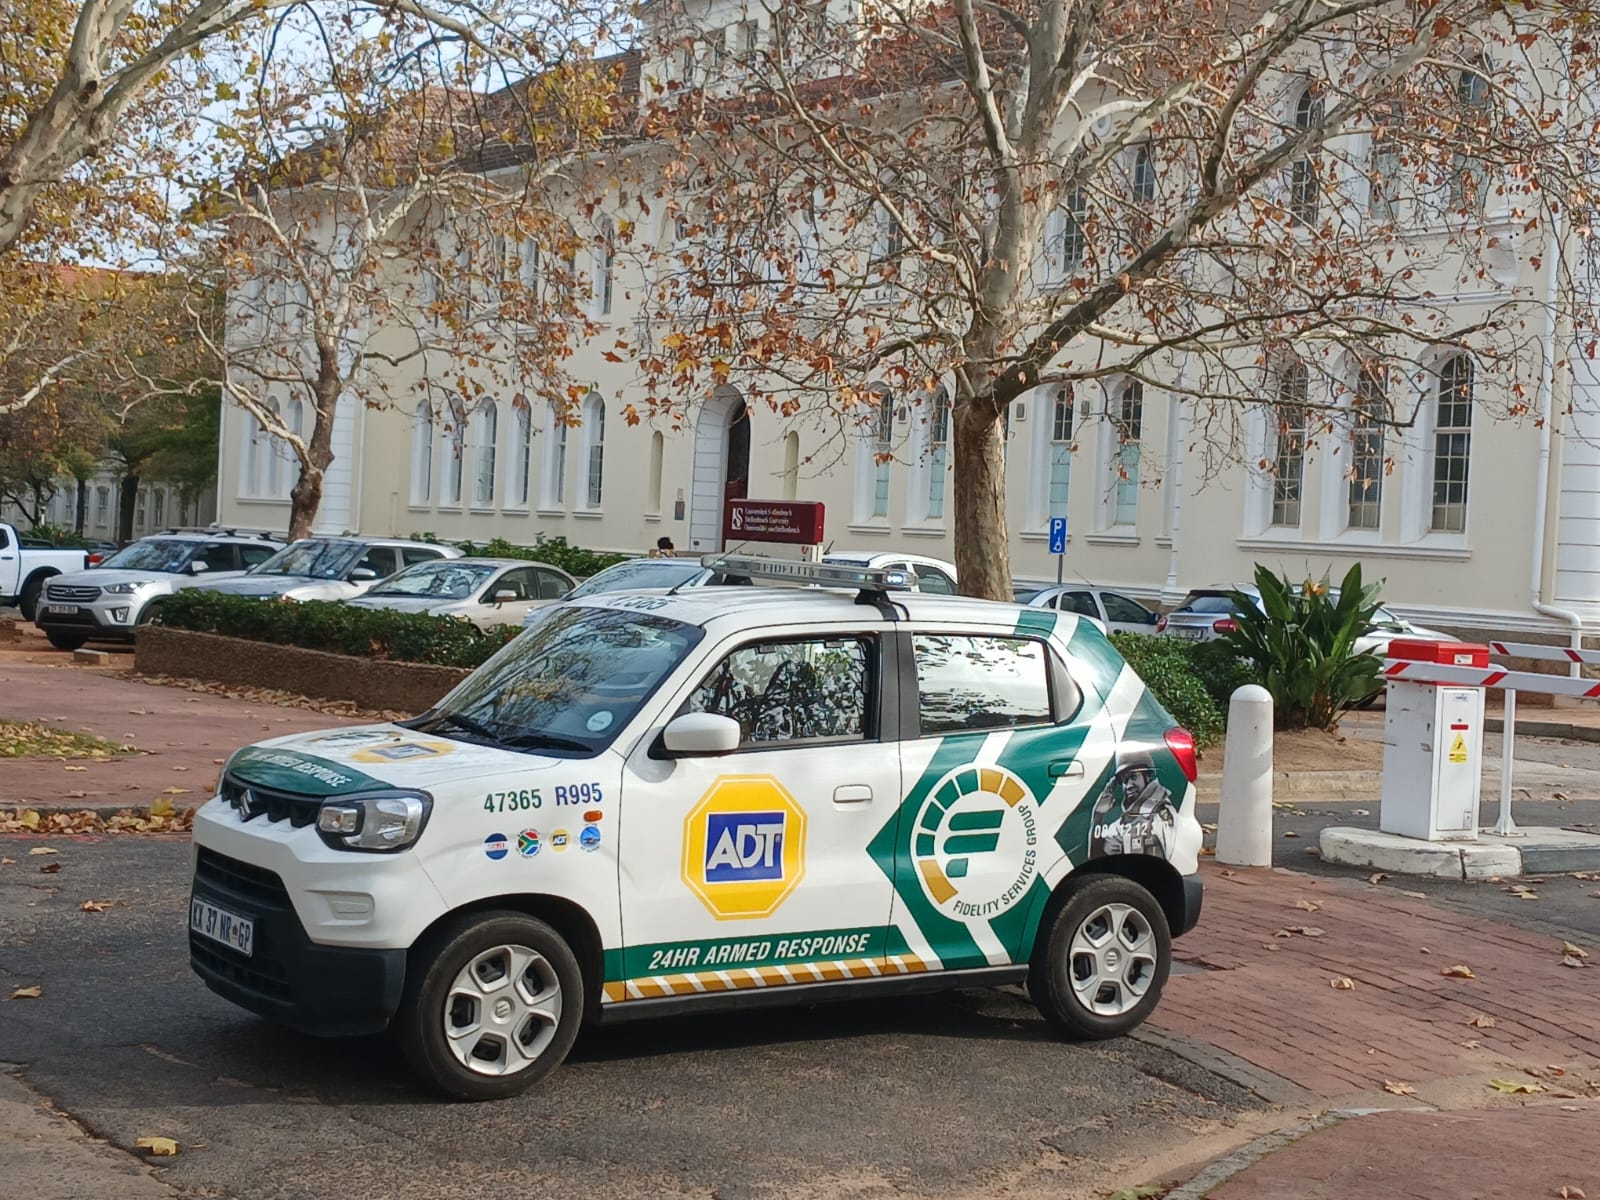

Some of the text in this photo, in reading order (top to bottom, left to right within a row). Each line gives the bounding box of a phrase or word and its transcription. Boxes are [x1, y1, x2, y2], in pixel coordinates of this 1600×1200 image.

[1054, 520, 1062, 534] P
[291, 762, 352, 787] RESPONSE
[484, 783, 603, 813] 47365 R995
[706, 823, 783, 870] ADT
[953, 804, 1037, 917] FIDELITY SERVICES GROUP
[206, 907, 218, 936] 37
[239, 921, 251, 951] GP
[648, 933, 871, 970] 24HR ARMED RESPONSE
